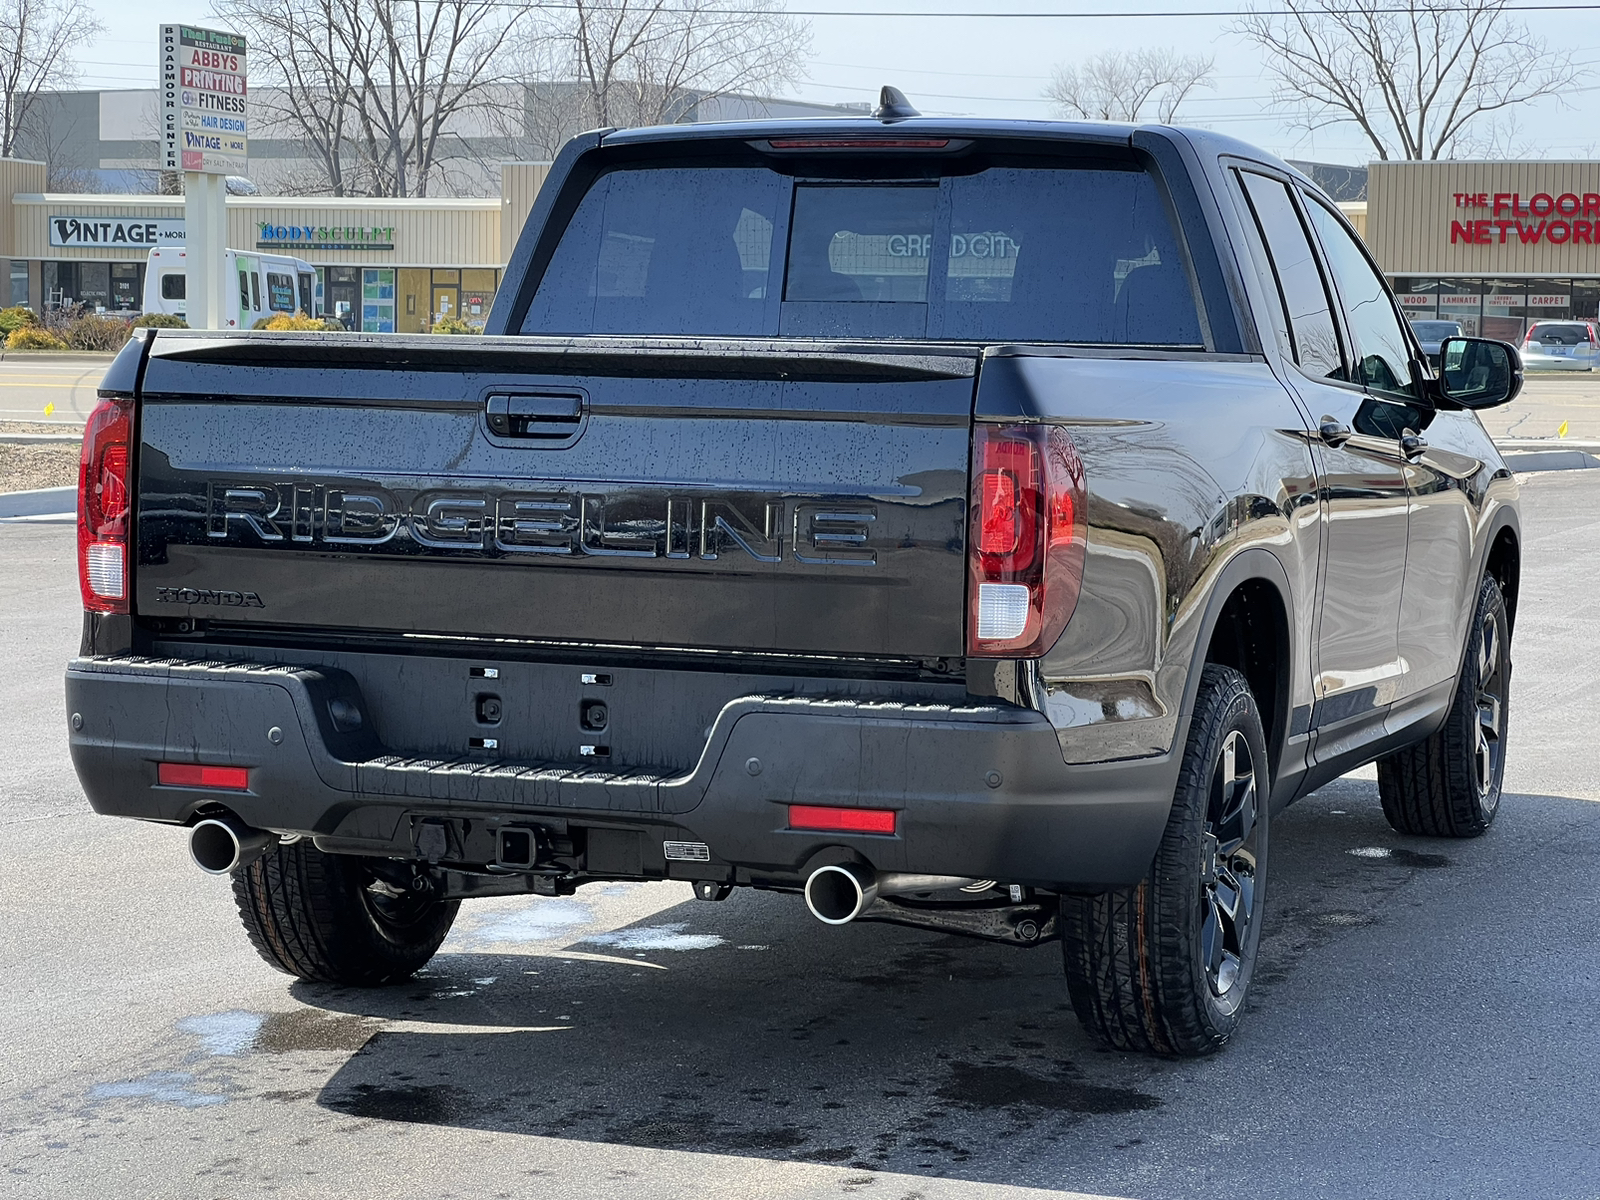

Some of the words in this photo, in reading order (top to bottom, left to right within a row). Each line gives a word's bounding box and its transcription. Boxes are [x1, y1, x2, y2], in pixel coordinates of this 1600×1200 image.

[195, 41, 232, 52] RESTAURANT
[165, 27, 175, 108] BROADMOOR
[191, 49, 238, 71] ABBYS
[184, 69, 243, 94] PRINTING
[198, 92, 245, 114] FITNESS
[201, 115, 218, 129] HAIR
[219, 118, 245, 132] DESIGN
[166, 114, 175, 167] CENTER
[185, 131, 221, 149] VINTAGE
[203, 158, 212, 166] DRY
[213, 159, 225, 167] SALT
[1453, 193, 1488, 207] THE
[1493, 193, 1600, 217] FLOOR
[54, 219, 158, 244] VINTAGE
[1403, 296, 1428, 304] WOOD
[1442, 296, 1477, 304] LAMINATE
[1532, 296, 1564, 305] CARPET
[205, 481, 878, 567] RIDGELINE
[156, 586, 266, 608] HONDA
